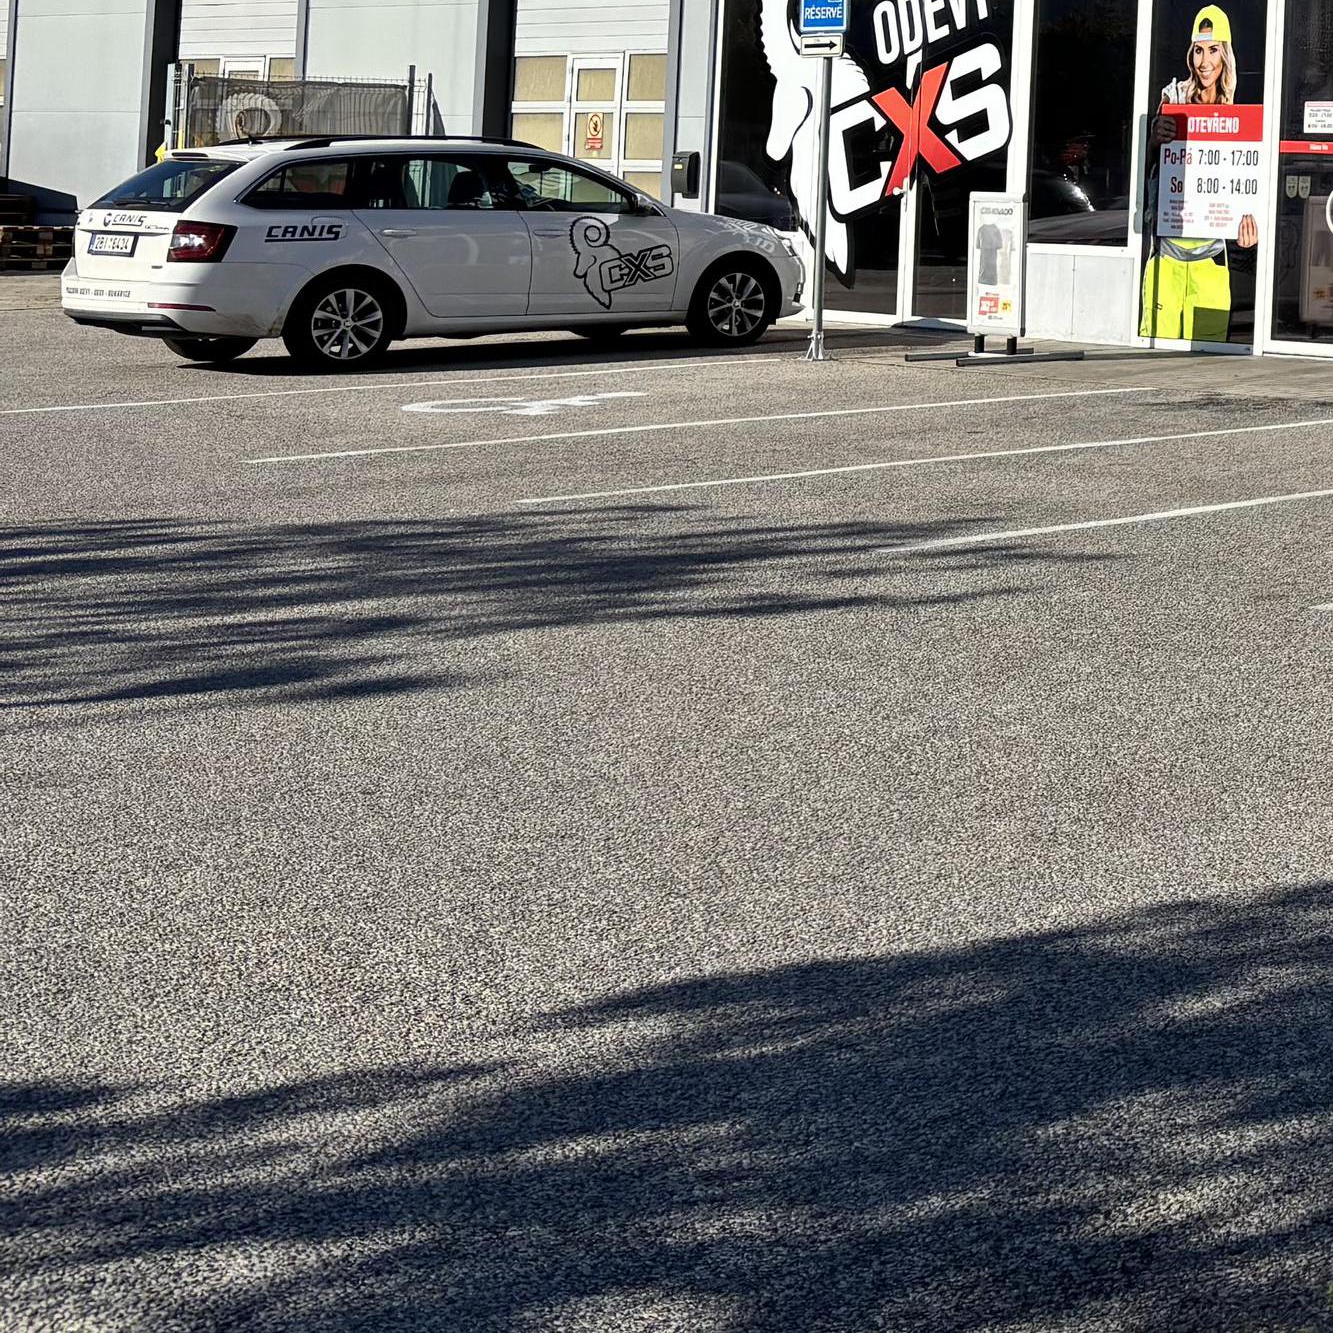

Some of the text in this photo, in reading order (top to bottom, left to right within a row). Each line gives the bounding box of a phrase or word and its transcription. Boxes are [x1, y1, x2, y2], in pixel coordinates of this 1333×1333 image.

[828, 42, 1013, 216] CXS
[1187, 112, 1240, 134] OTEVŘENO
[1198, 149, 1220, 165] 7:00
[1231, 150, 1259, 166] 17:00
[1170, 176, 1184, 193] So
[1196, 178, 1219, 194] 8:00
[1230, 178, 1258, 194] 14:00
[111, 214, 148, 227] CANIS
[264, 224, 343, 243] CANIS
[600, 243, 675, 292] CXS
